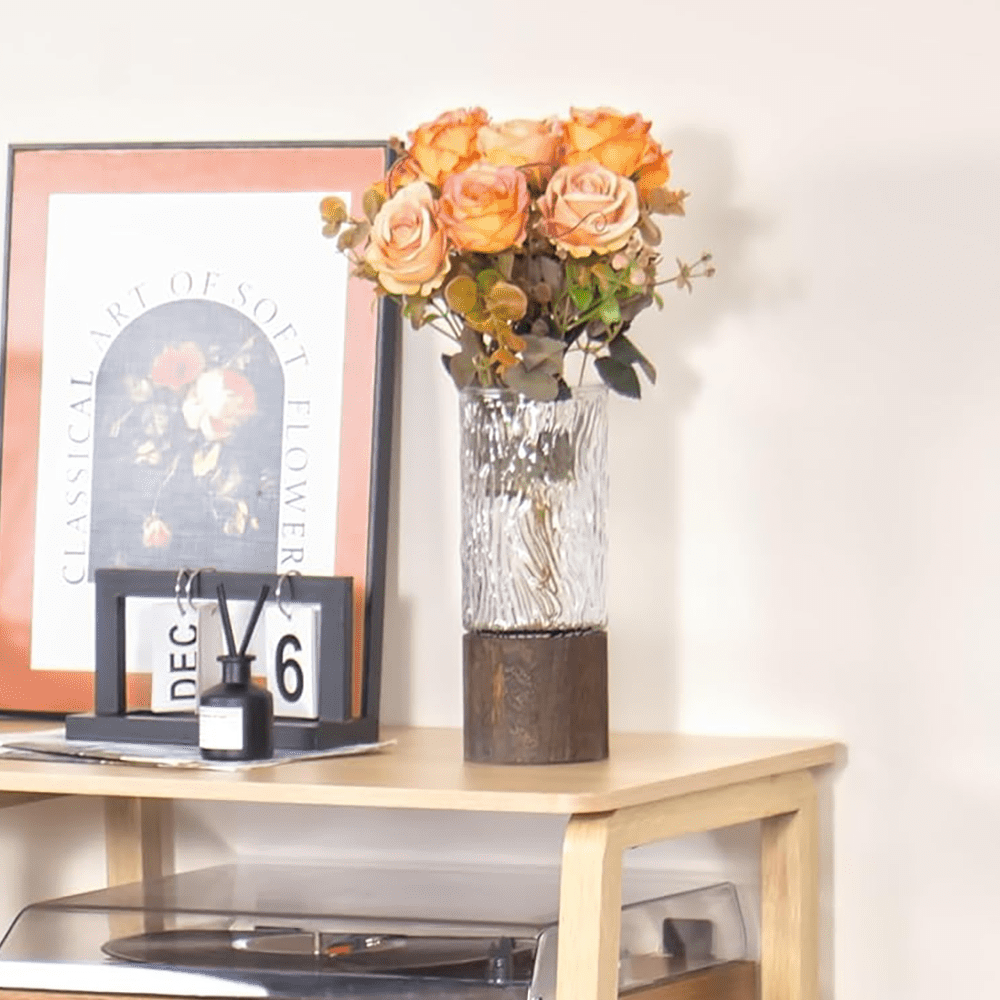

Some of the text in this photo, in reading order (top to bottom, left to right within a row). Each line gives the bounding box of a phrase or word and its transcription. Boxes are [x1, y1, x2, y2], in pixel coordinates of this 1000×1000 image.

[62, 371, 94, 584] CLASSICAL
[90, 282, 146, 352] ART
[170, 270, 221, 295] OF
[232, 281, 309, 366] SOFT
[169, 624, 197, 701] DEC
[275, 634, 304, 702] 6
